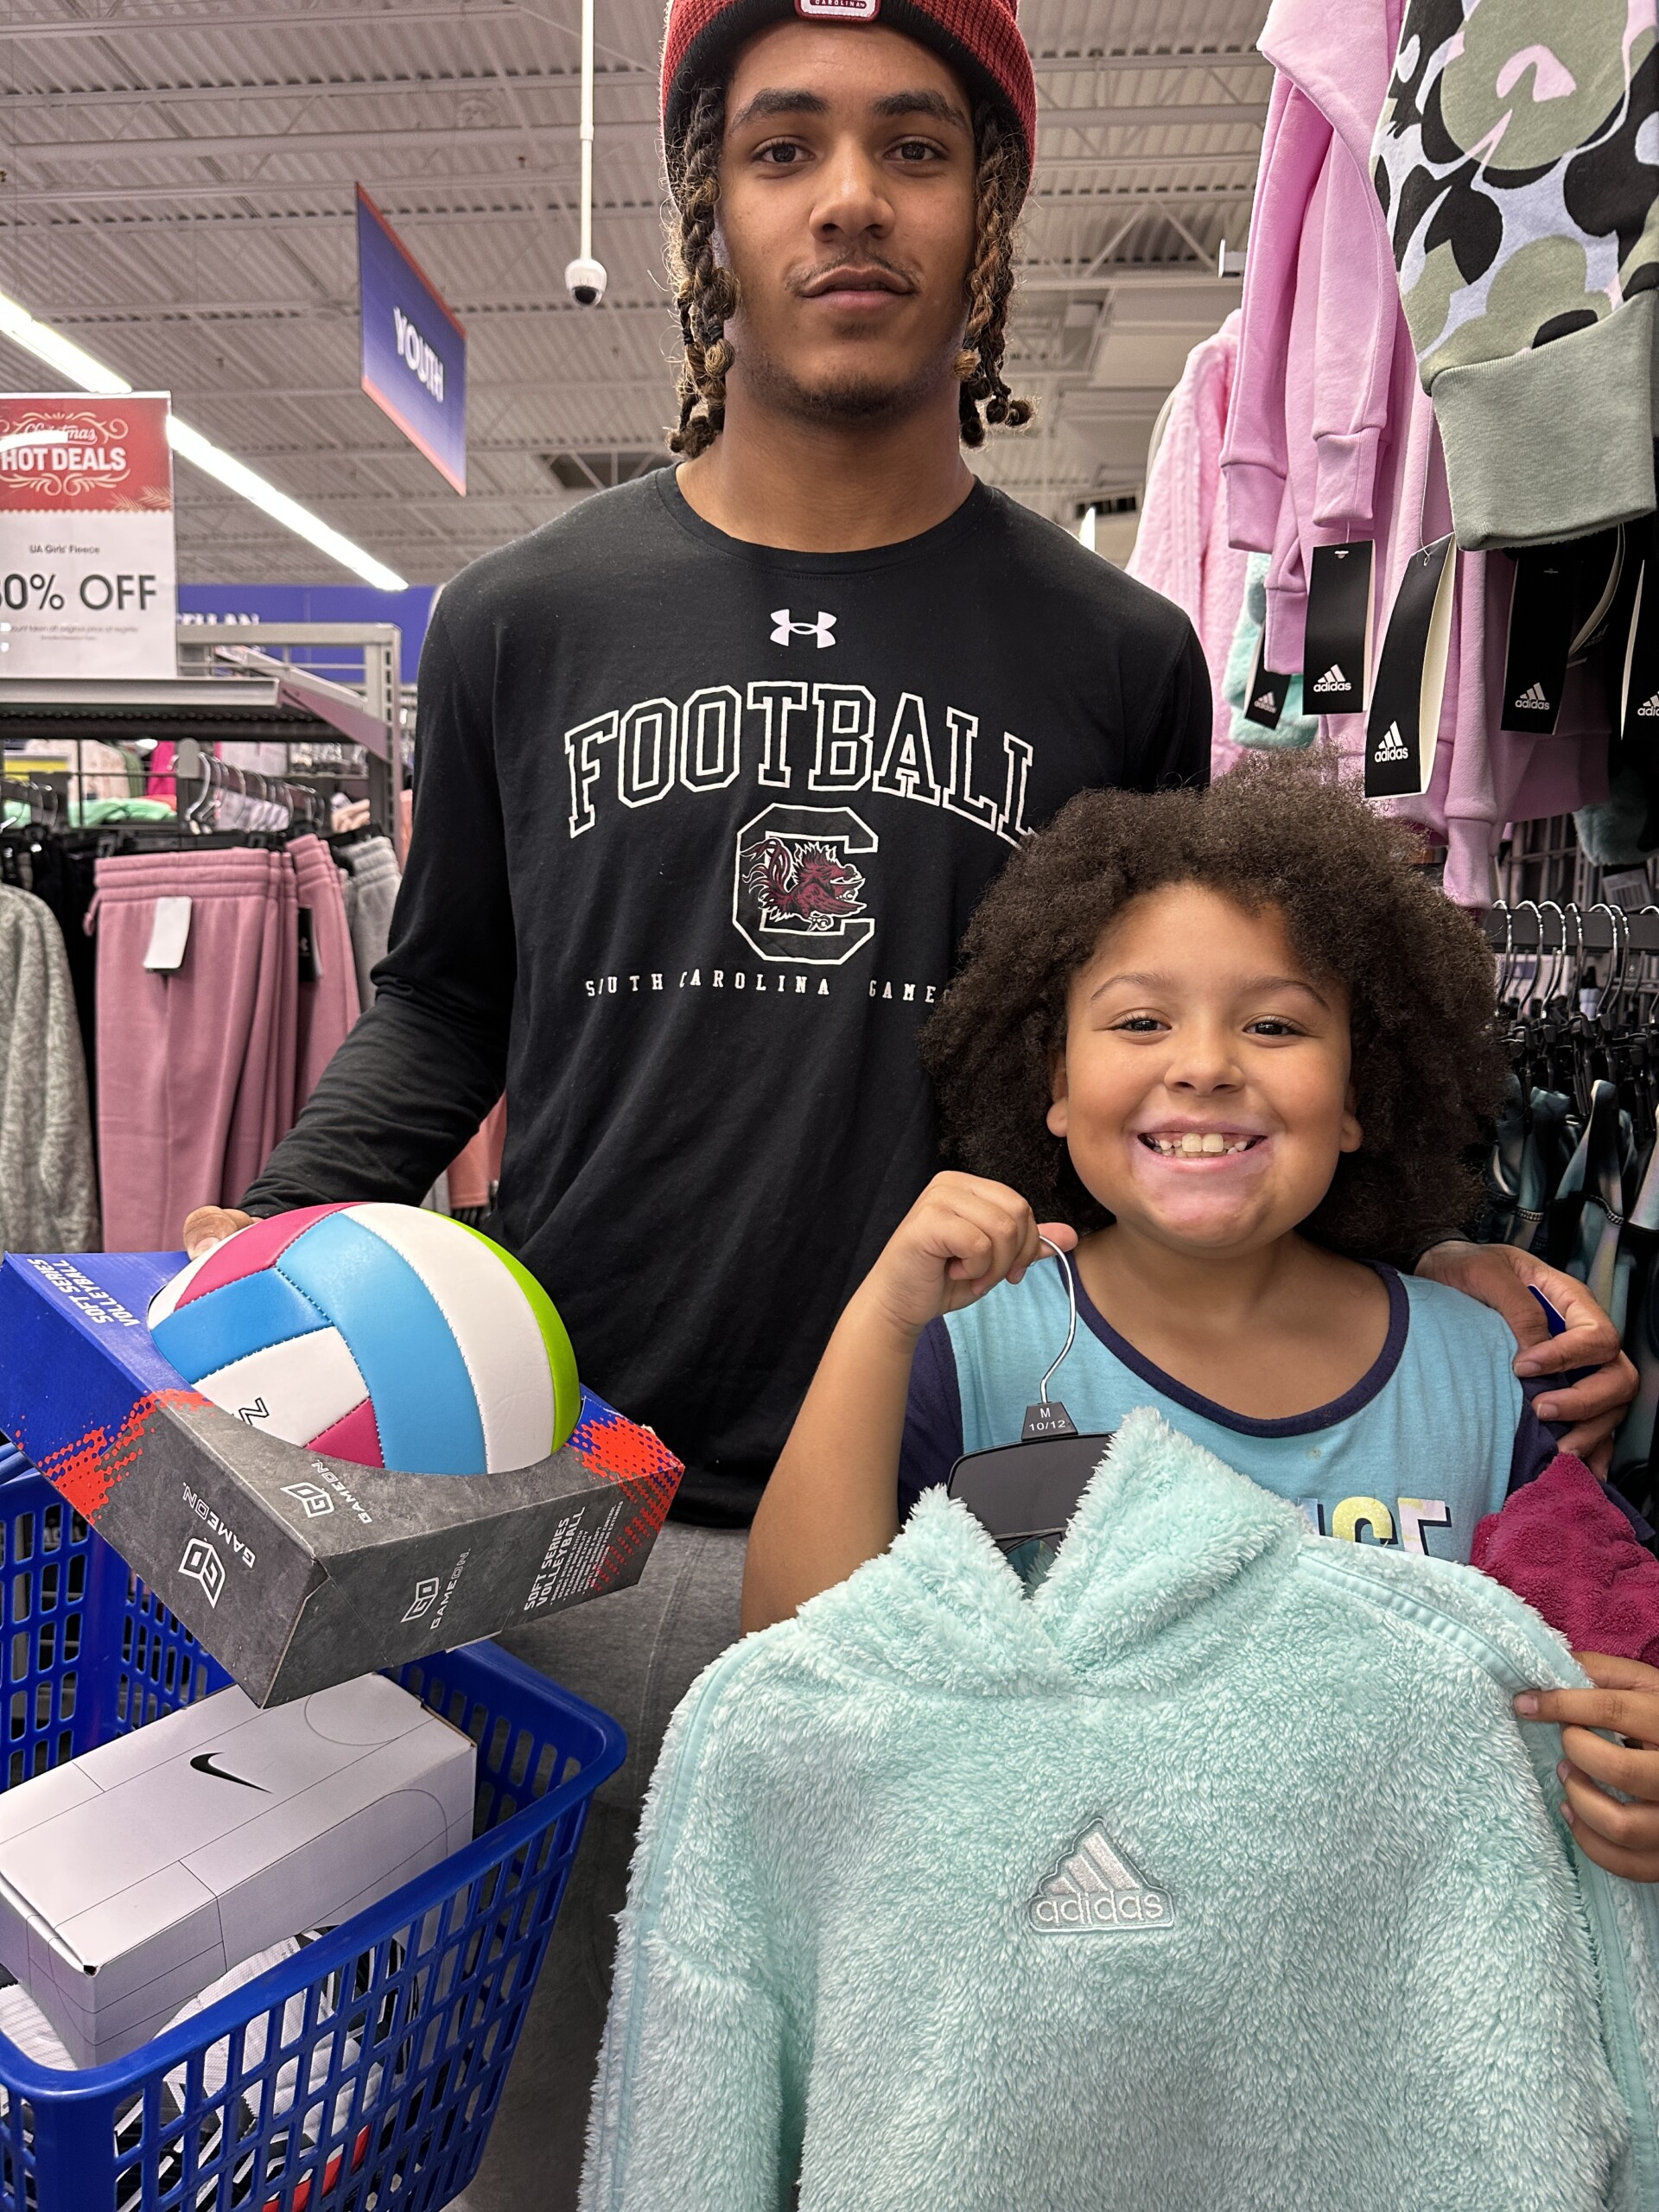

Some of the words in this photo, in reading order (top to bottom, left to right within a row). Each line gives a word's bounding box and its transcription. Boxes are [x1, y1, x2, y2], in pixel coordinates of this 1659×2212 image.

[394, 306, 444, 403] YOUTH
[1, 447, 49, 472] HOT
[51, 446, 128, 472] DEALS
[0, 573, 65, 611] 0%
[79, 574, 157, 611] OFF
[1313, 681, 1352, 692] adidas
[1515, 698, 1550, 710] adidas
[564, 680, 1037, 851] FOOTBALL
[1374, 746, 1409, 763] adidas
[27, 1258, 81, 1293] SERIES
[52, 1259, 141, 1327] VOLLEYBALL
[68, 1295, 115, 1324] SOFT
[1028, 1420, 1065, 1432] 10/12
[1039, 1407, 1051, 1419] M
[524, 1573, 547, 1611] SOFT
[541, 1517, 569, 1569] SERIES
[536, 1506, 585, 1607] VOLLEYBALL
[1036, 1890, 1163, 1926] adidas
